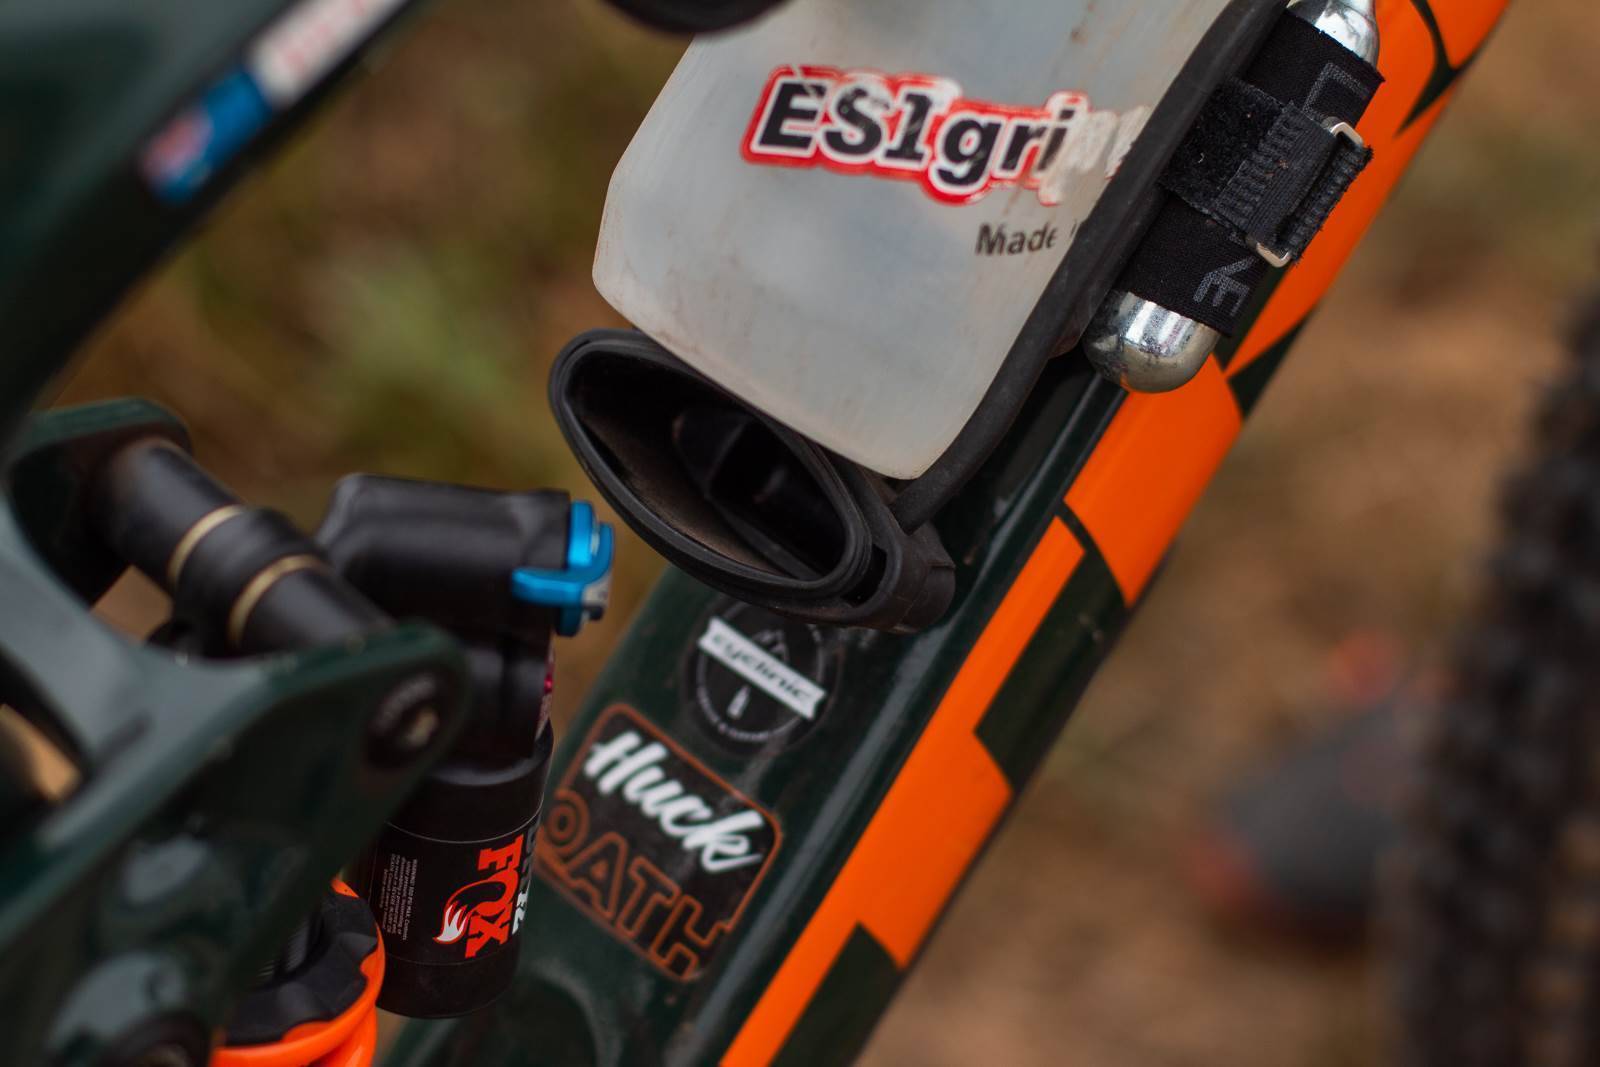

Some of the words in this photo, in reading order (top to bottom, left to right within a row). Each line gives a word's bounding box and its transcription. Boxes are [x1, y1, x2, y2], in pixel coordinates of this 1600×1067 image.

[583, 731, 764, 873] Huck
[434, 832, 525, 959] FOX
[538, 789, 733, 982] OATH
